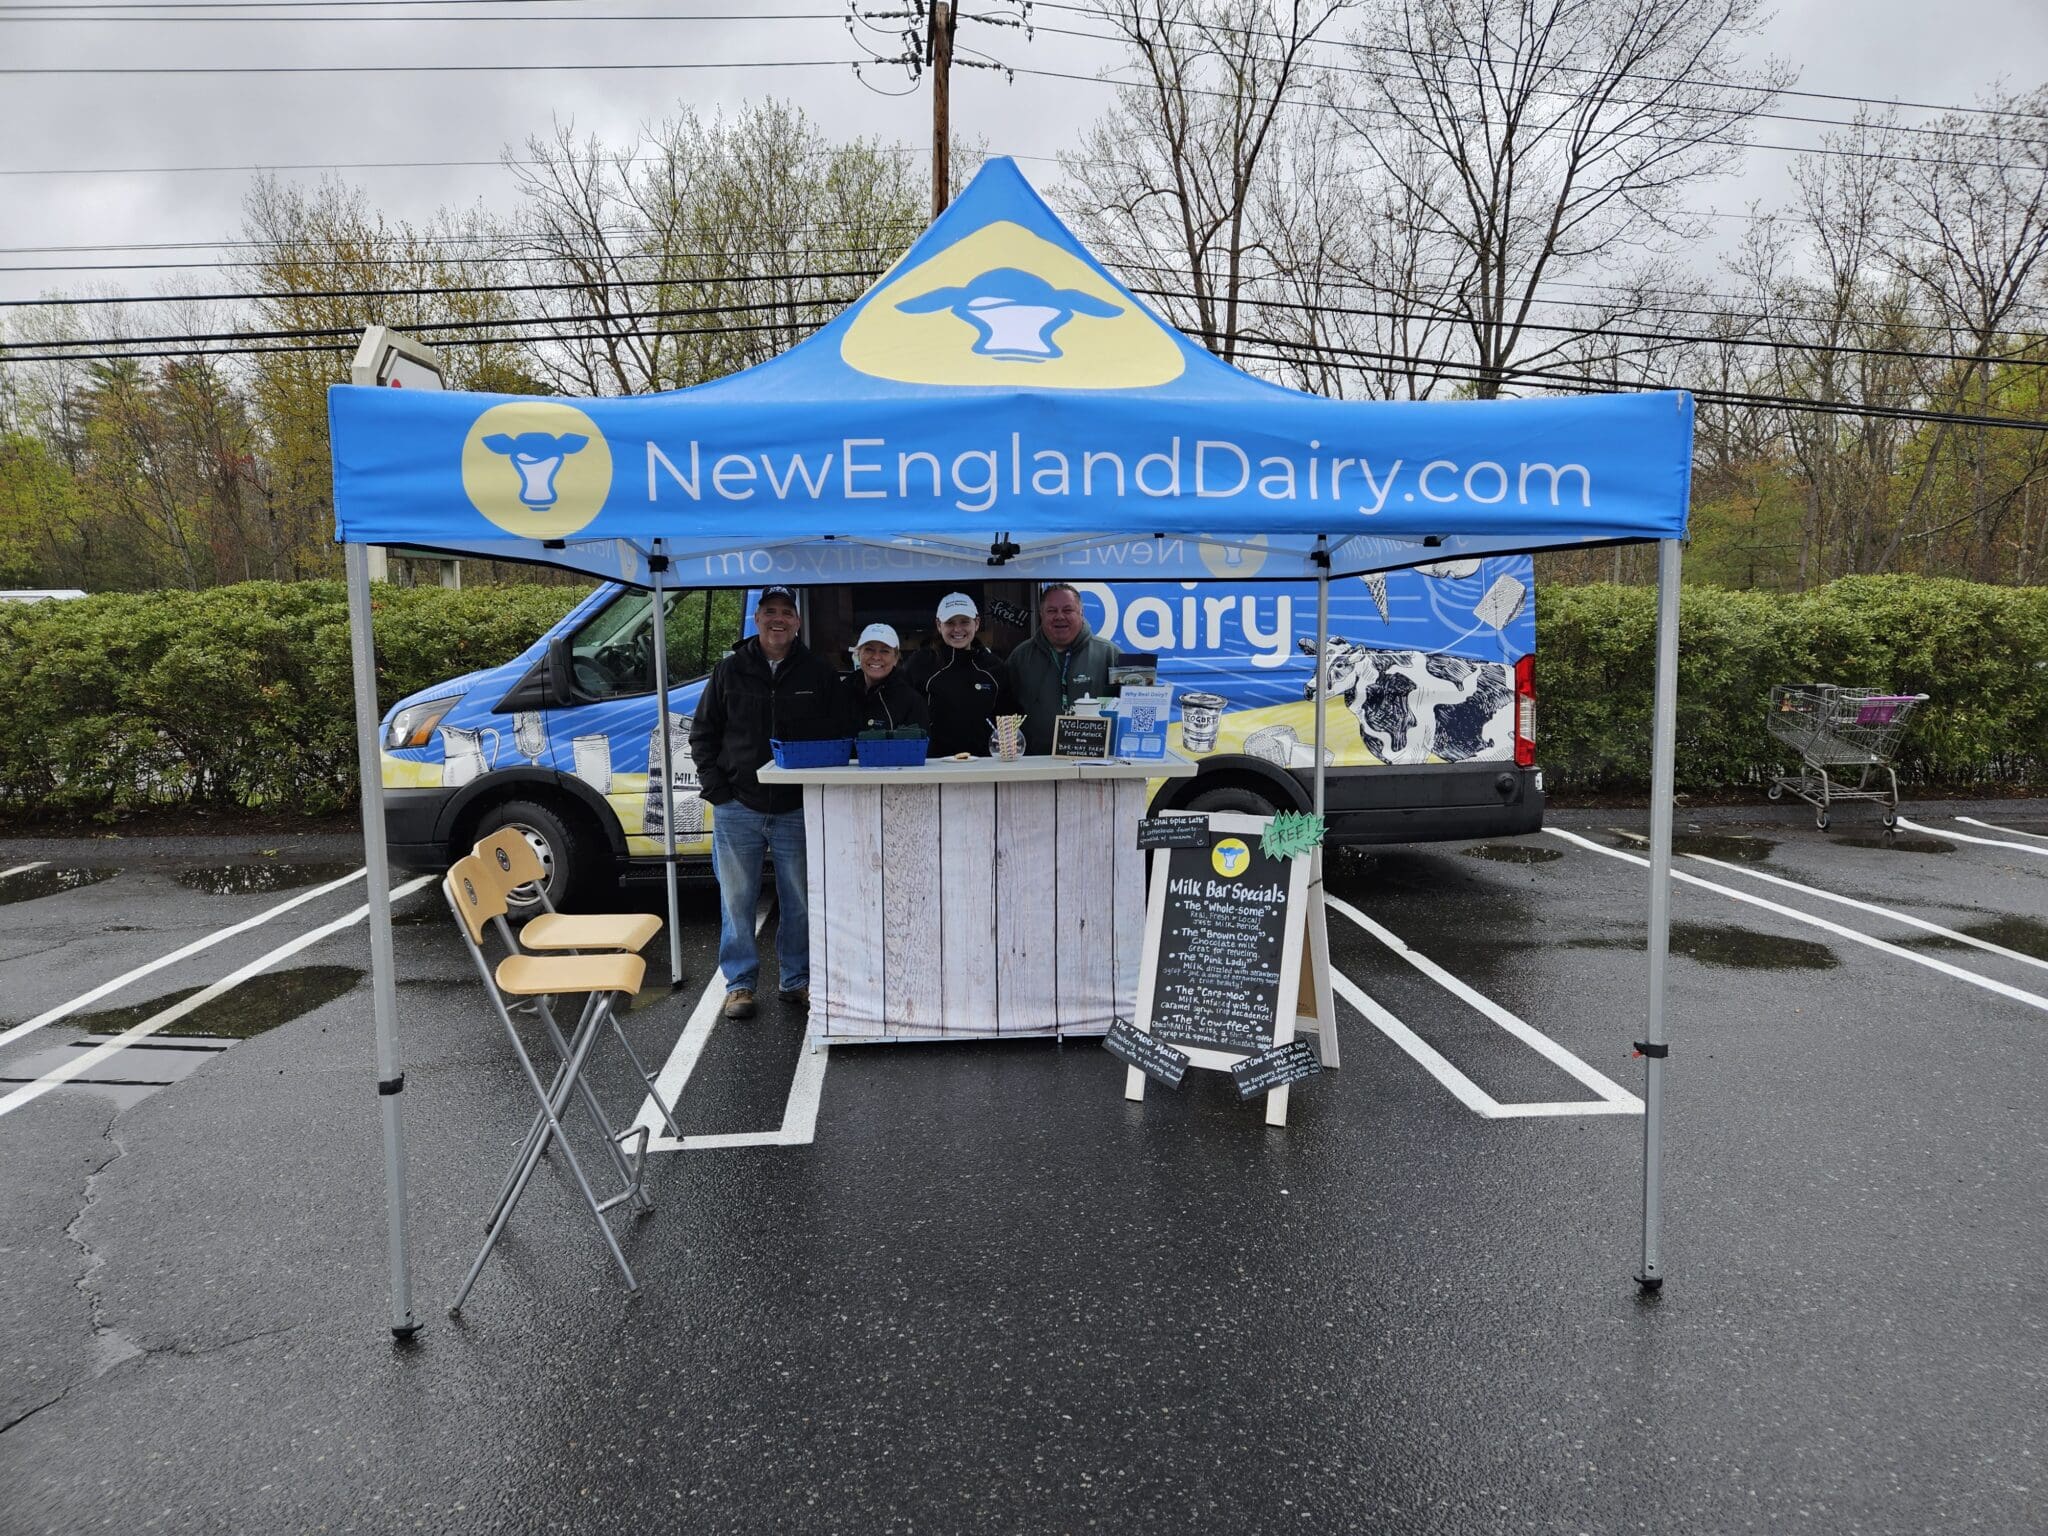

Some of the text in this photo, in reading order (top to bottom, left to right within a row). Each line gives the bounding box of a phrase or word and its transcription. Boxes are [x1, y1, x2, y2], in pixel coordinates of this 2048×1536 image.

[646, 432, 1593, 514] NewEnglandDairy.com
[1269, 818, 1311, 846] FREE!
[1170, 878, 1285, 903] Milk Bar Specials
[1184, 900, 1201, 910] The
[1181, 928, 1198, 937] The
[1200, 928, 1235, 940] "Brown
[1191, 937, 1236, 947] Chocolate
[1178, 952, 1196, 961] The
[1206, 965, 1232, 974] drizzled
[1175, 985, 1194, 995] The
[1161, 1001, 1190, 1011] caramel
[1231, 1010, 1273, 1022] decadence!
[1232, 1002, 1251, 1011] with
[1172, 1014, 1193, 1025] The
[1116, 1020, 1129, 1031] The
[1233, 1063, 1247, 1073] The
[1264, 1045, 1294, 1061] Jumped
[1273, 1057, 1288, 1068] the
